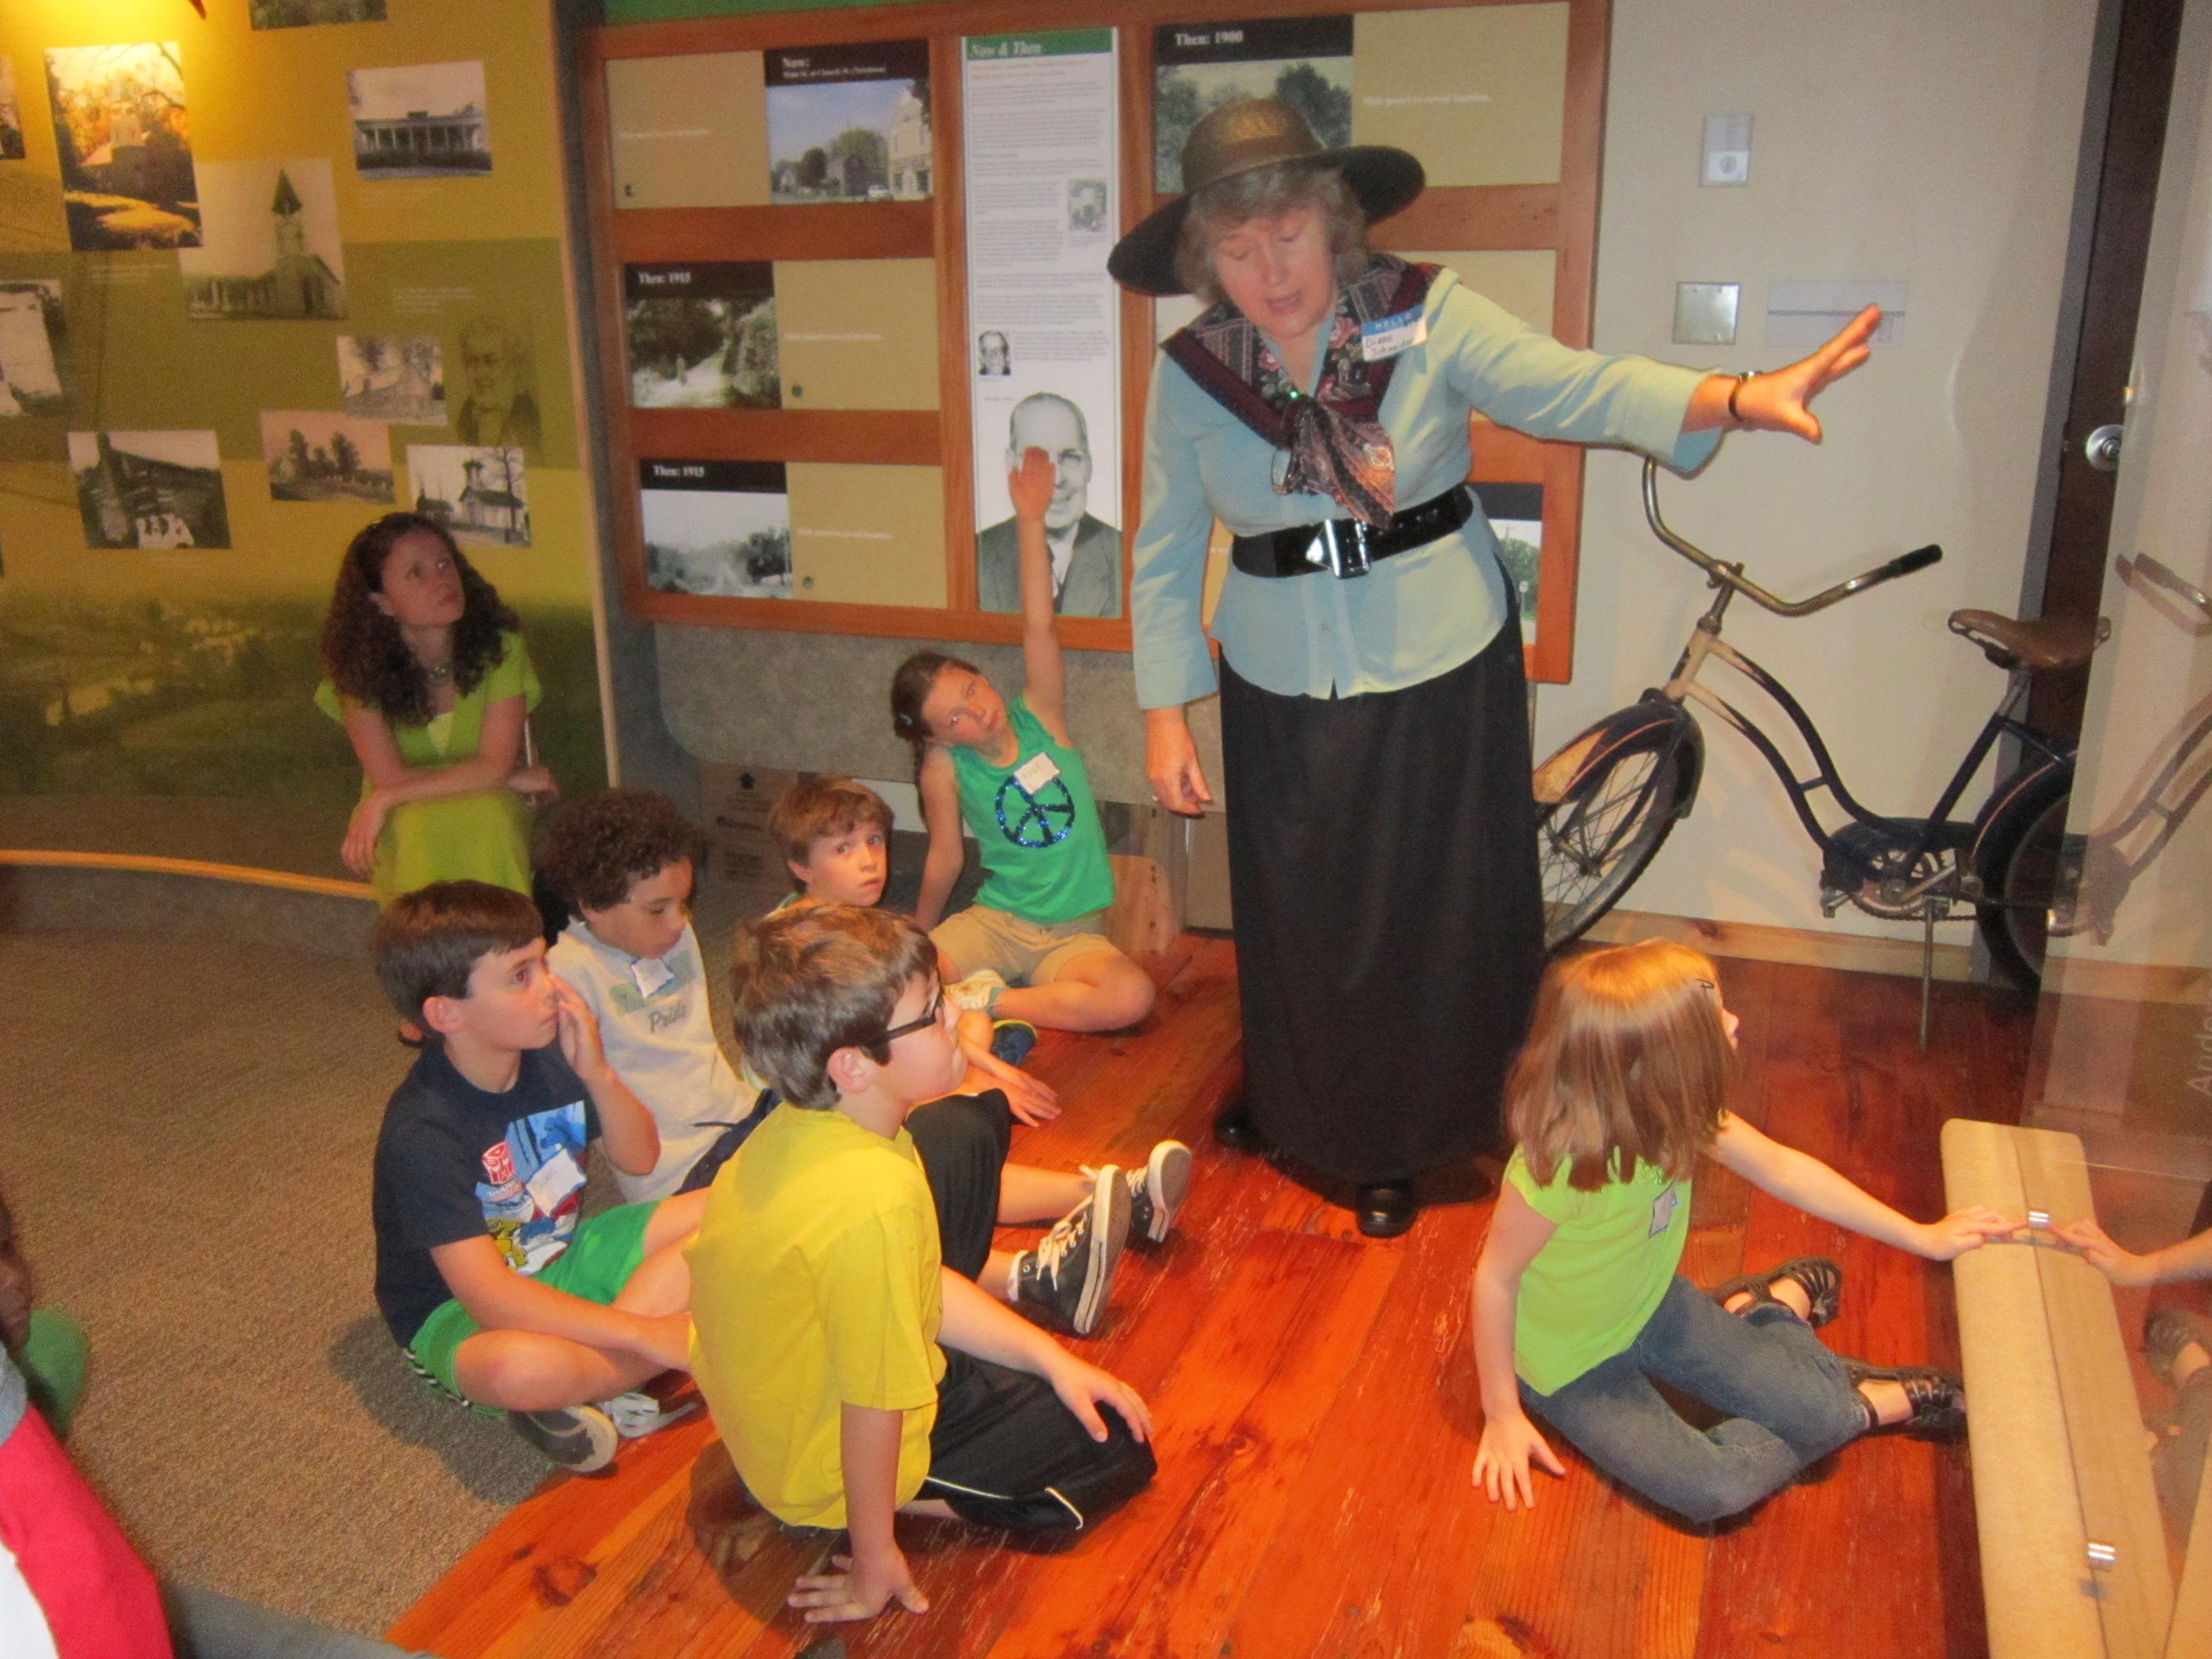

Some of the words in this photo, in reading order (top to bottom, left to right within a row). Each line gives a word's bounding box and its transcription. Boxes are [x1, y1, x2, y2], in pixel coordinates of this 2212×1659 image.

[972, 44, 996, 56] Now
[998, 42, 1008, 56] &
[1014, 41, 1042, 56] Then
[638, 272, 665, 284] Then:
[1375, 313, 1412, 329] HELLO
[653, 465, 680, 476] Then:
[647, 1000, 687, 1033] Pride
